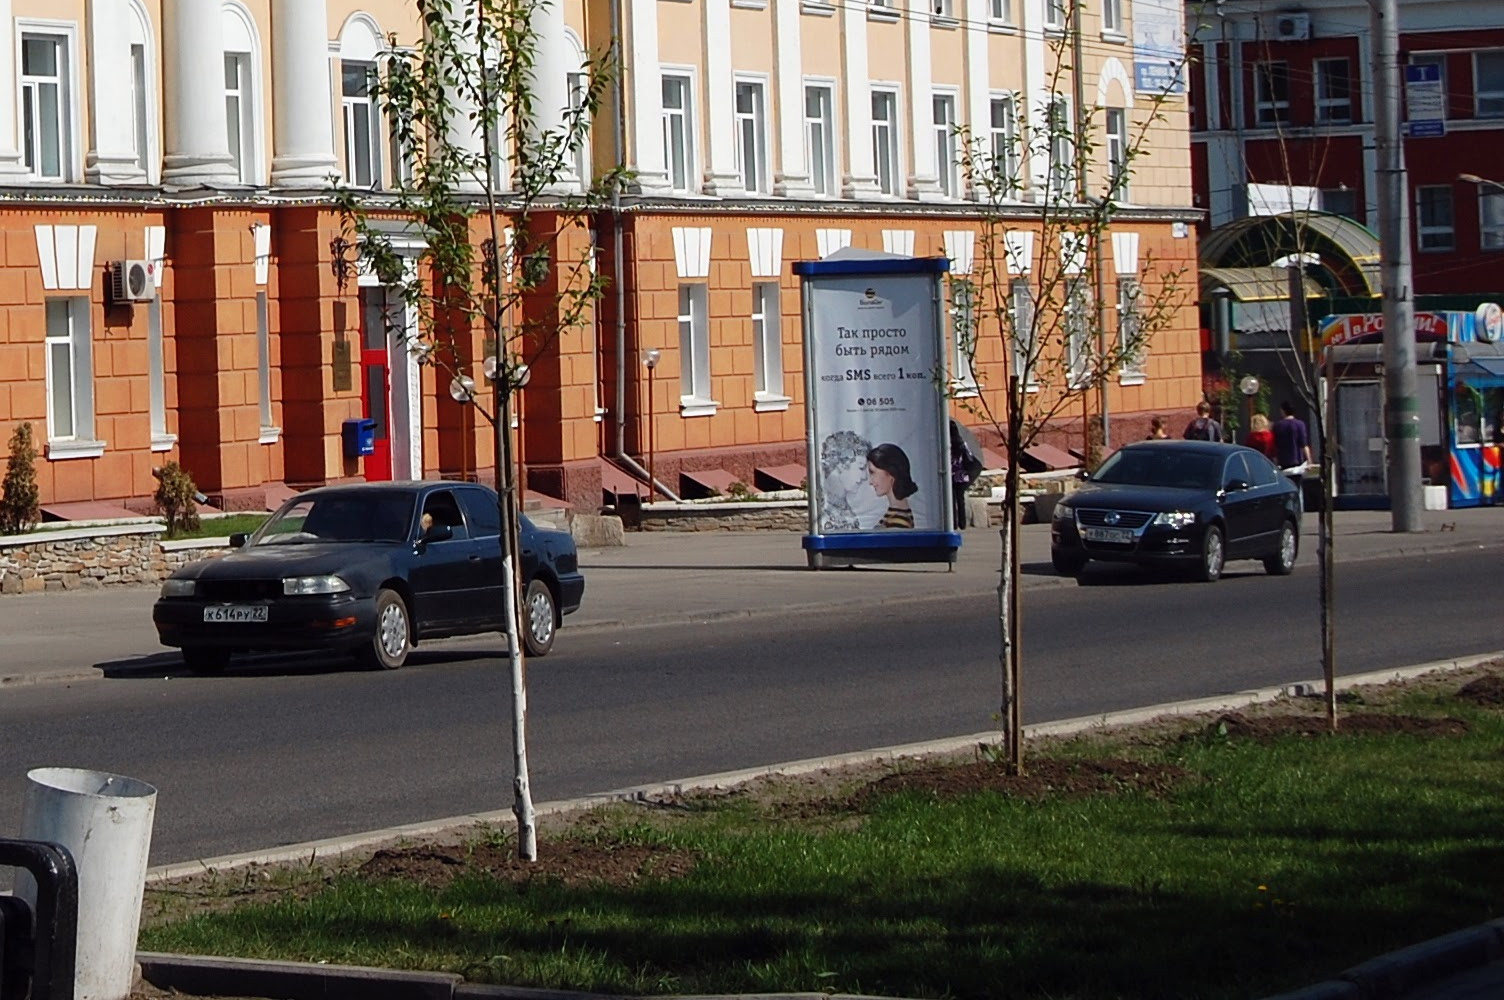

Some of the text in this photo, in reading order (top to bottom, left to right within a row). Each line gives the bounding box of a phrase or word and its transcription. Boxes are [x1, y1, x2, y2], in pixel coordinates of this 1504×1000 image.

[837, 327, 907, 341] Так просто
[835, 344, 910, 358] быть рядом
[846, 369, 871, 381] SMS
[897, 367, 905, 380] 1
